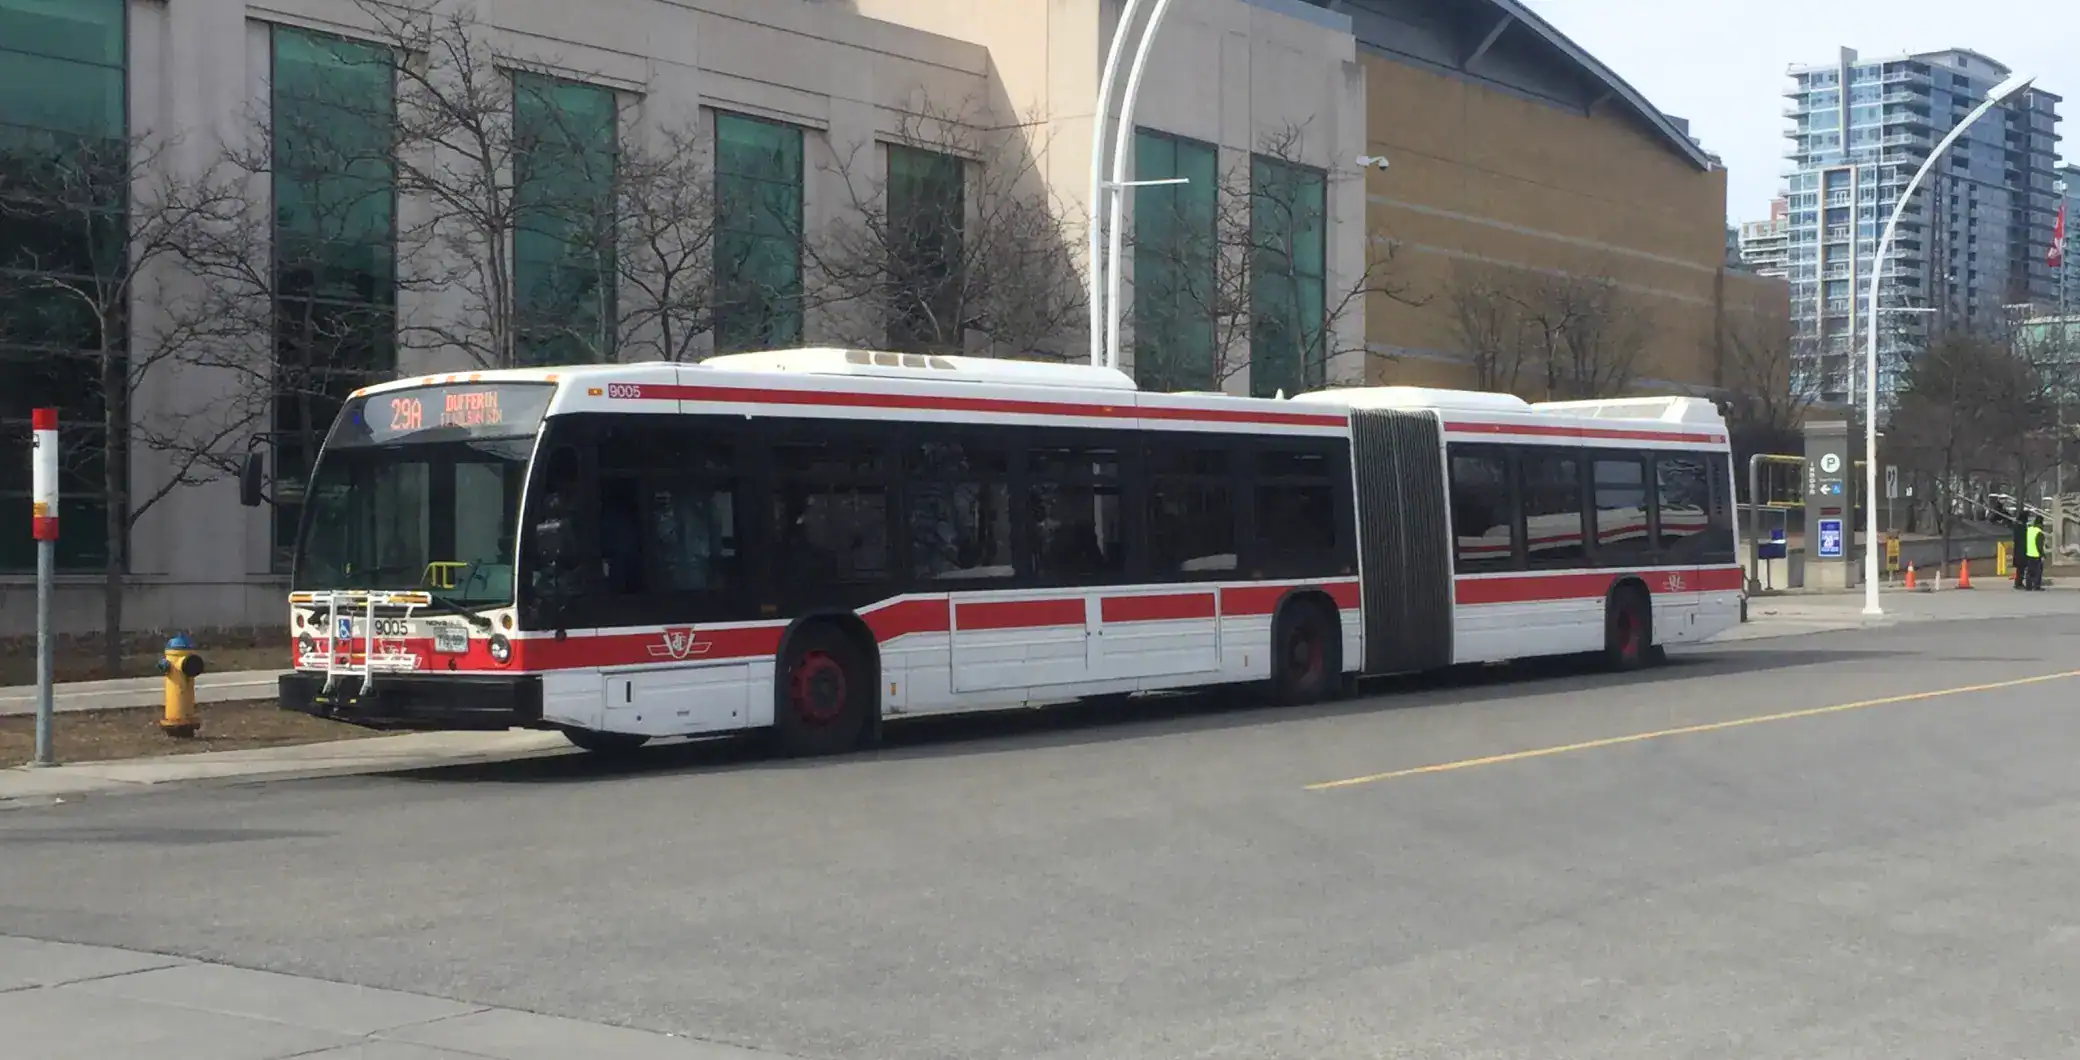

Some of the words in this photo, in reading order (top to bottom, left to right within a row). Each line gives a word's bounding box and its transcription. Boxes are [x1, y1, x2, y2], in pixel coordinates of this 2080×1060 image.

[609, 384, 641, 399] 9005
[390, 397, 423, 430] 29A
[445, 391, 499, 412] DUFFERIN
[374, 619, 409, 636] 9005
